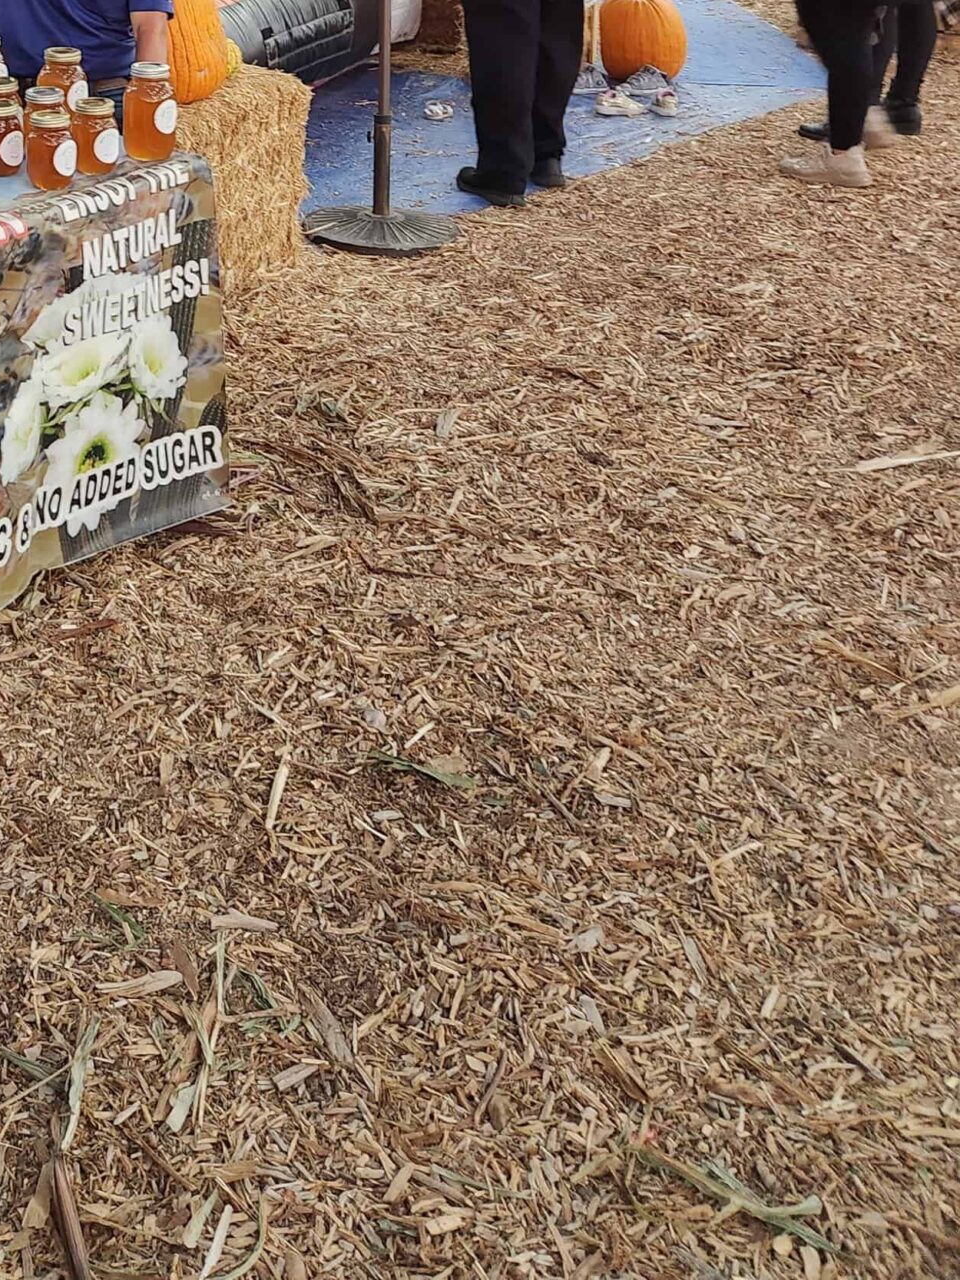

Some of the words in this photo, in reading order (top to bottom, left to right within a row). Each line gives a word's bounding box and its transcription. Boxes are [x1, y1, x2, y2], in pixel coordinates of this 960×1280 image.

[48, 176, 137, 222] ENJOY
[130, 160, 189, 194] THE
[82, 208, 182, 281] NATURAL
[62, 258, 210, 346] SWEETNESS!
[36, 486, 63, 524] NO
[69, 457, 137, 513] ADDED
[143, 431, 218, 484] SUGAR
